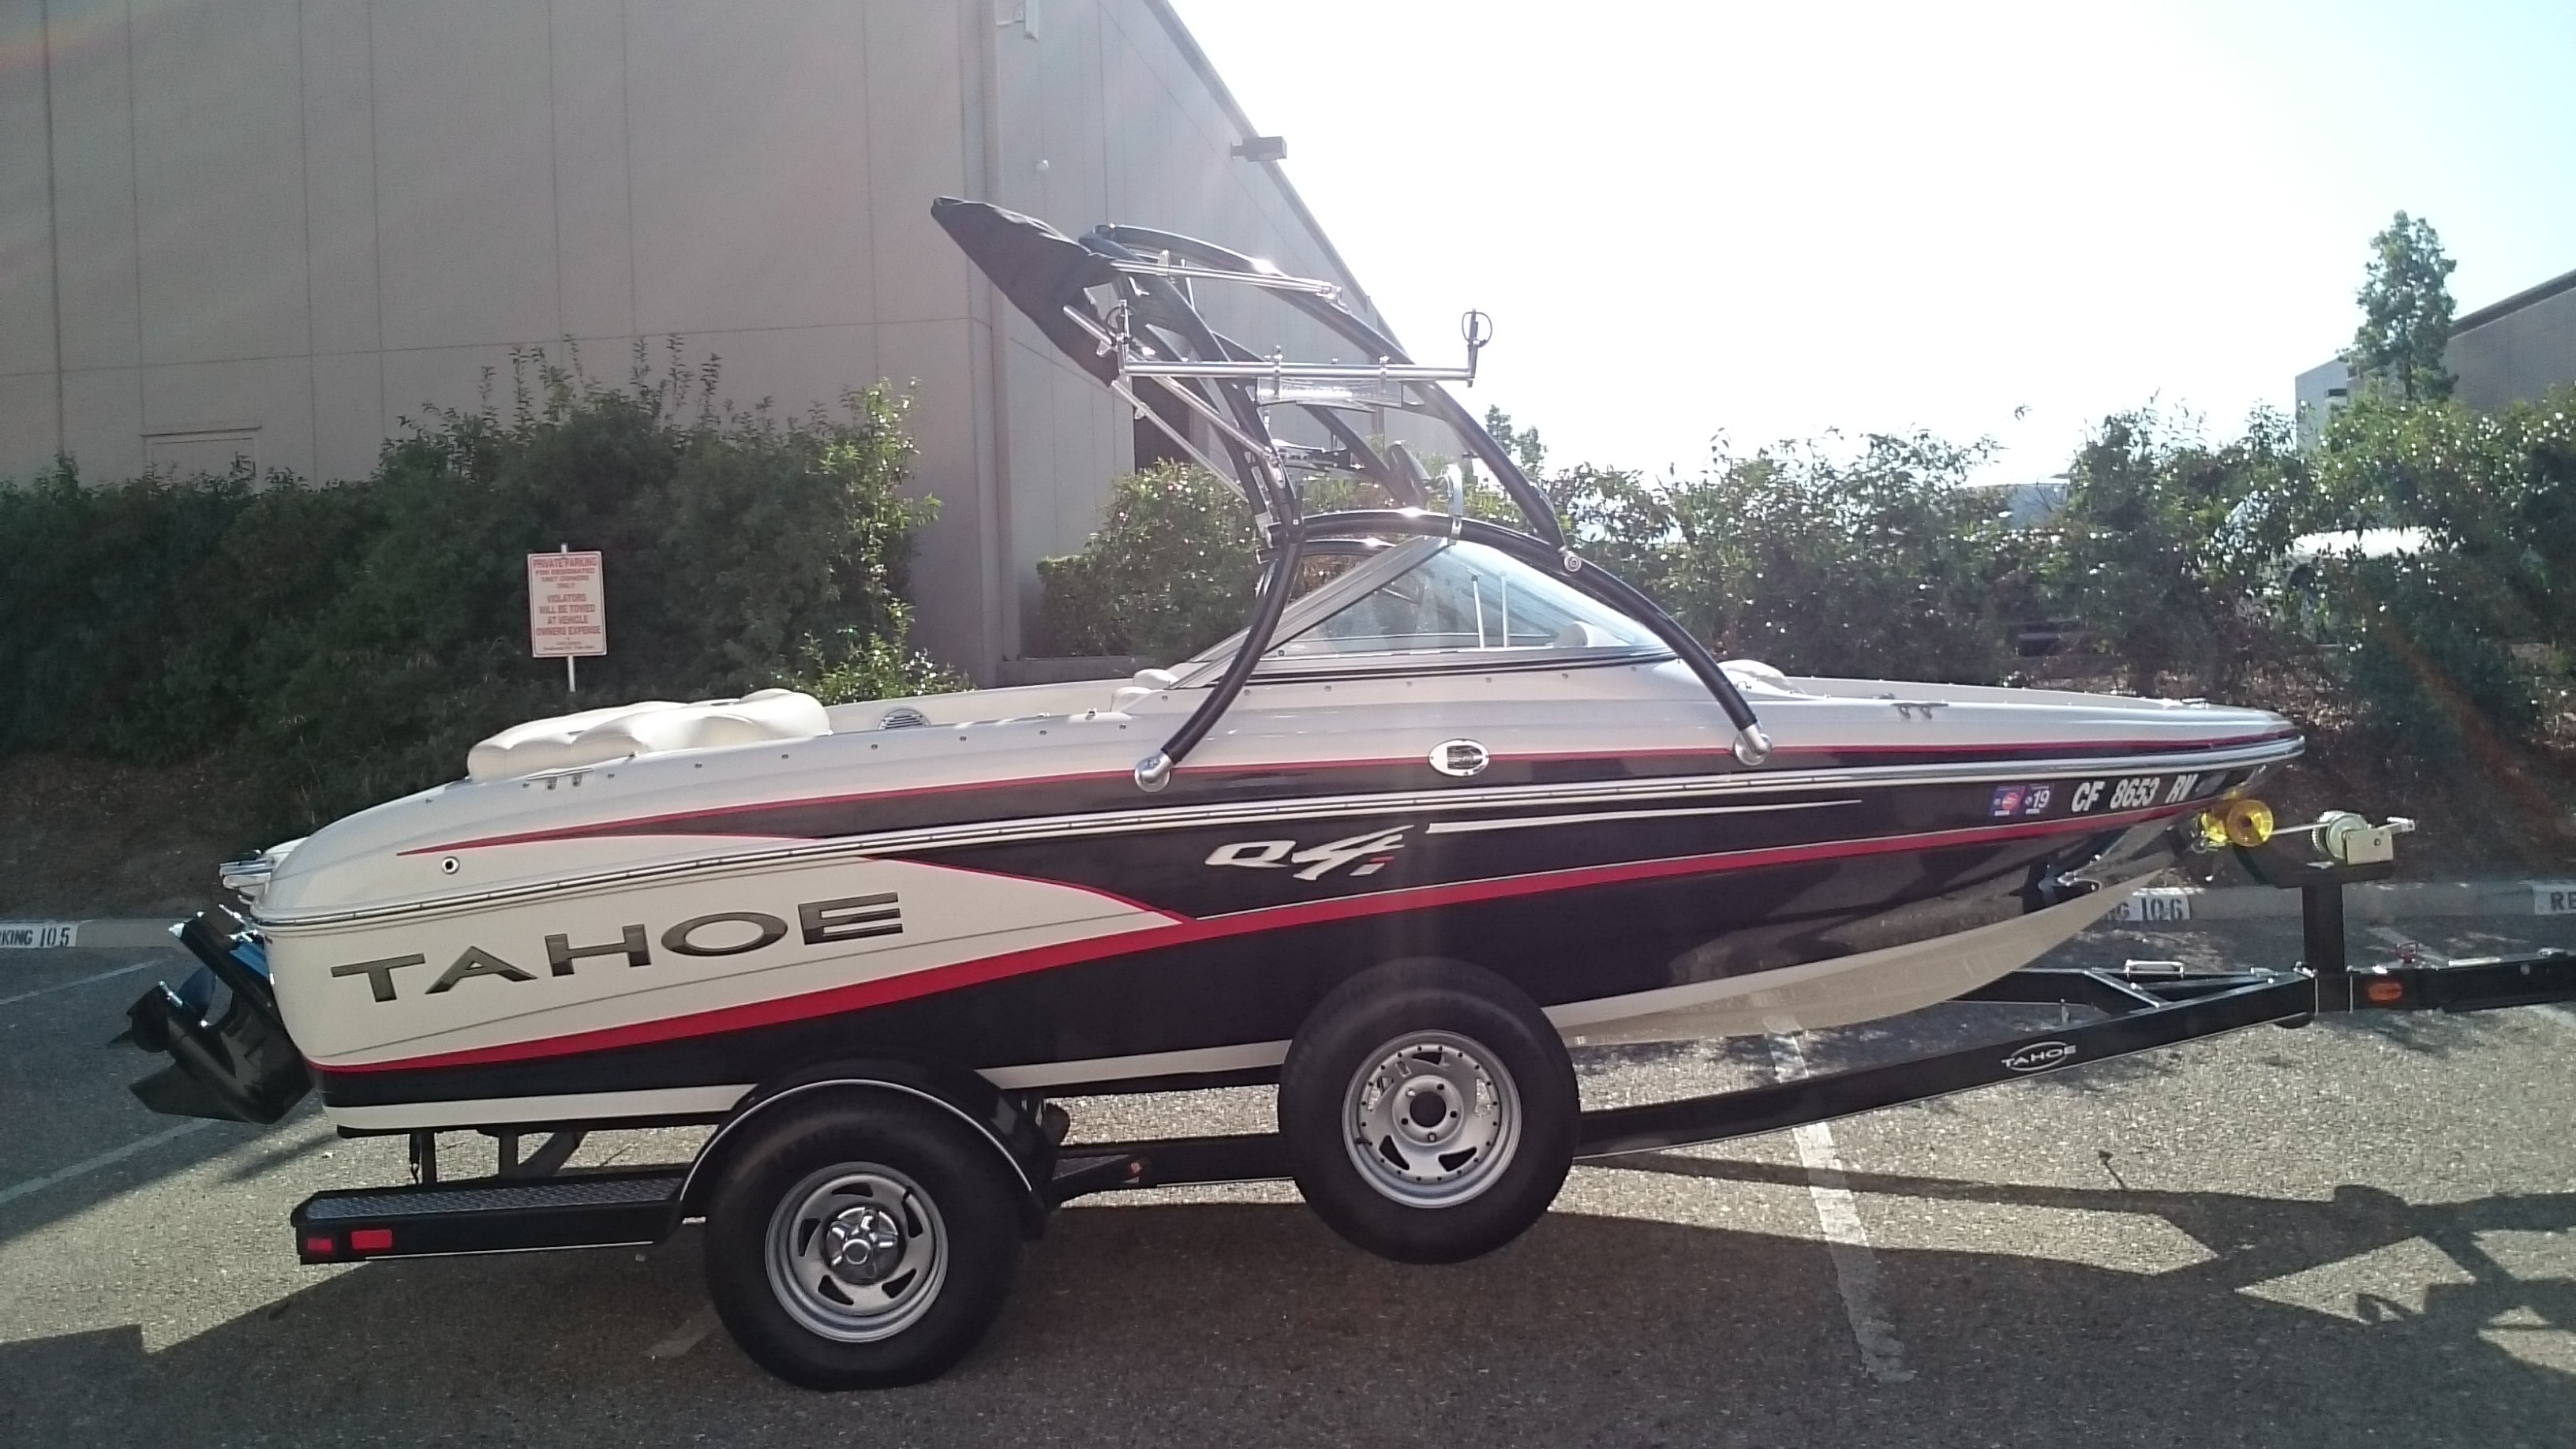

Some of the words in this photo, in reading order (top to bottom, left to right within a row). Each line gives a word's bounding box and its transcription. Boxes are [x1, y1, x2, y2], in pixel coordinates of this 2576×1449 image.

[533, 558, 563, 568] PRIVATE
[565, 556, 597, 567] PARKING
[547, 593, 586, 603] VIOLATORS
[539, 605, 556, 614] WILL
[569, 604, 596, 613] TOWED
[559, 615, 588, 624] VEHICLE
[568, 625, 601, 635] EXPENSE
[2032, 789, 2050, 809] 19
[2071, 780, 2106, 813] CF
[2109, 777, 2161, 810] 8653
[2140, 897, 2183, 921] 106
[0, 929, 33, 945] KING
[39, 927, 70, 947] 105
[331, 892, 904, 1003] TAHOE
[2001, 1045, 2076, 1067] TAHOE
